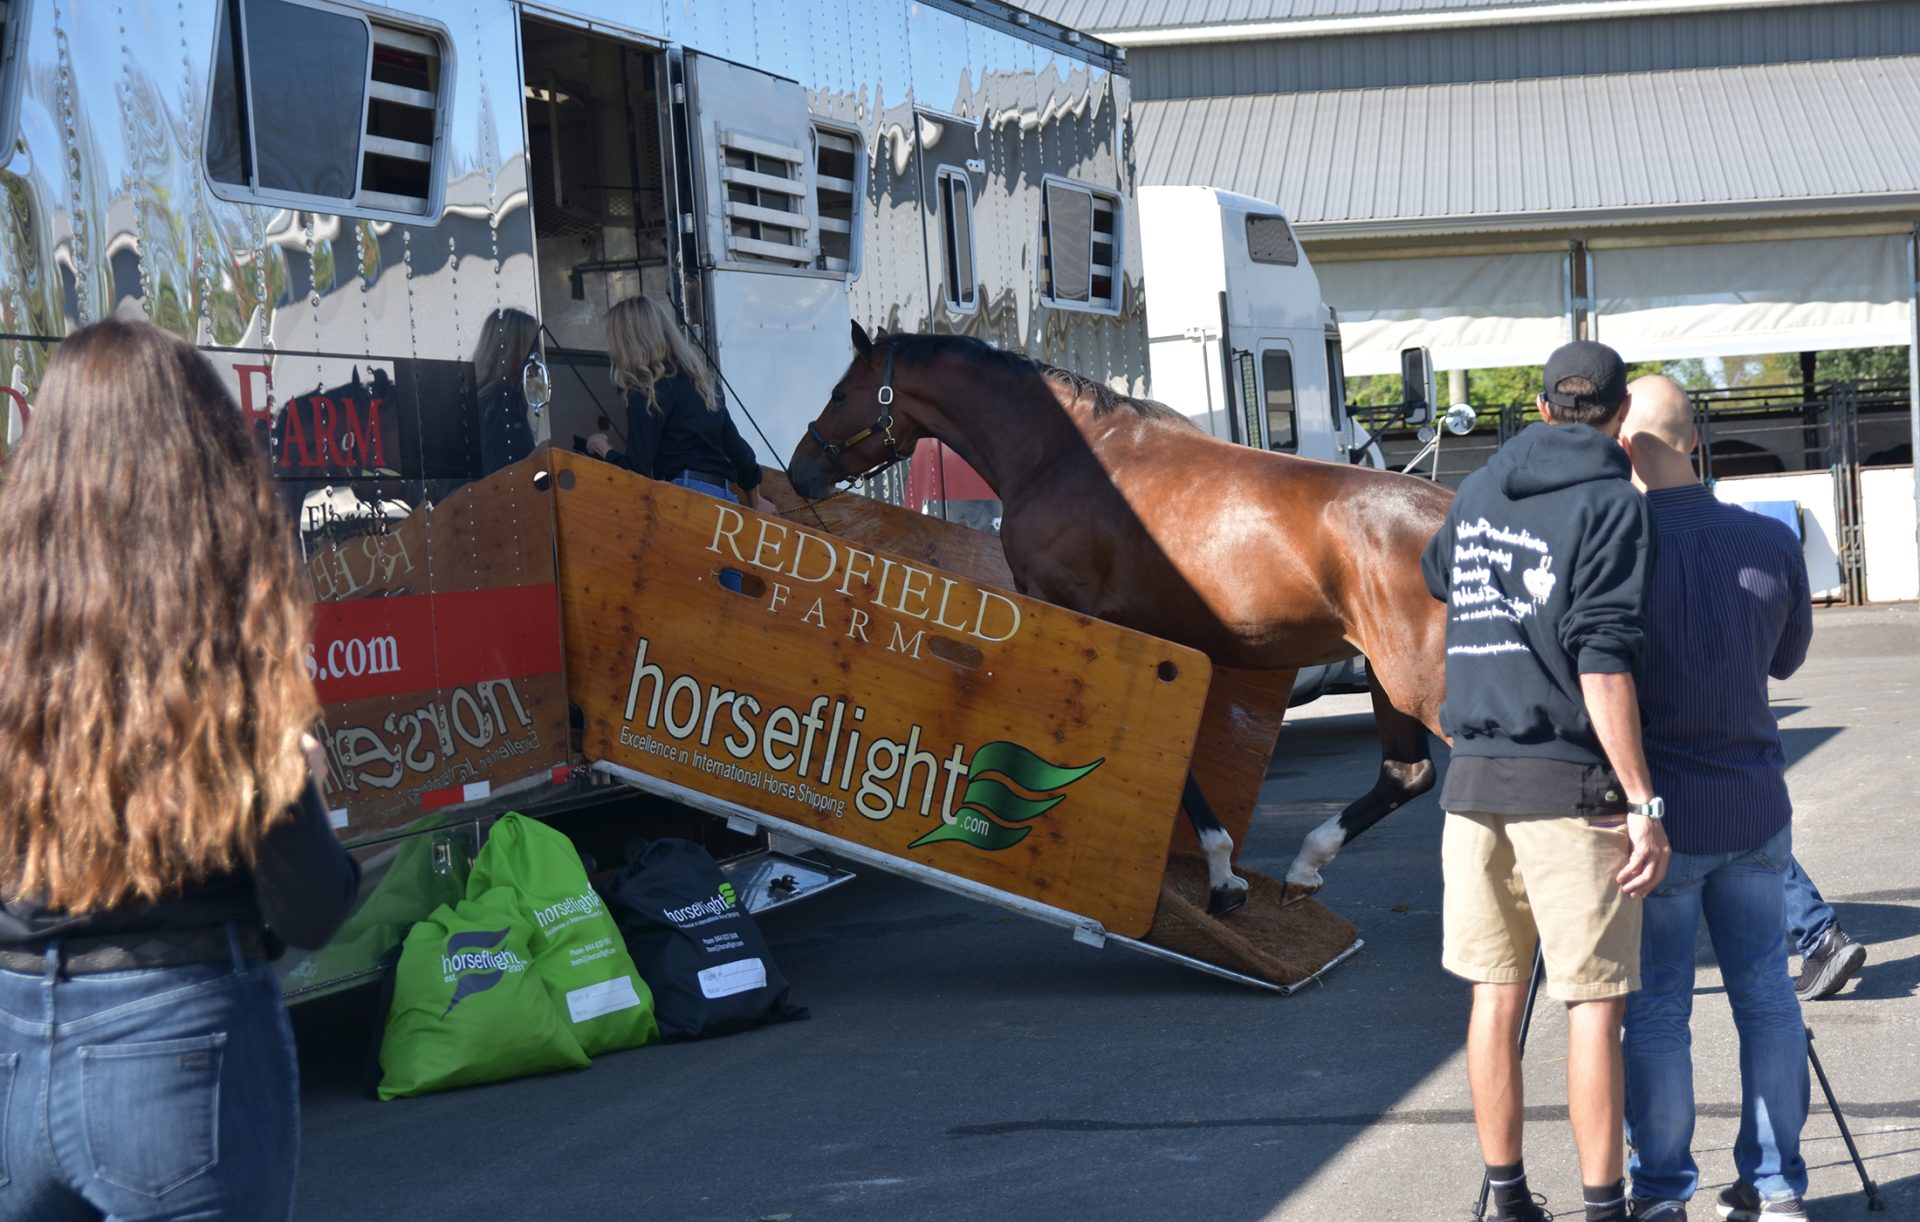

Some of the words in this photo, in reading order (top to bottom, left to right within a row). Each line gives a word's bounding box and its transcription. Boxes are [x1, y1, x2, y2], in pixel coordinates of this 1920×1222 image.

[705, 505, 1021, 642] REDFIELD
[767, 582, 926, 660] FARM
[620, 725, 677, 760] Excellence
[678, 745, 689, 764] in
[691, 749, 762, 788] International
[762, 772, 796, 799] Horse
[797, 783, 845, 818] Shipping
[623, 638, 969, 824] horseflight
